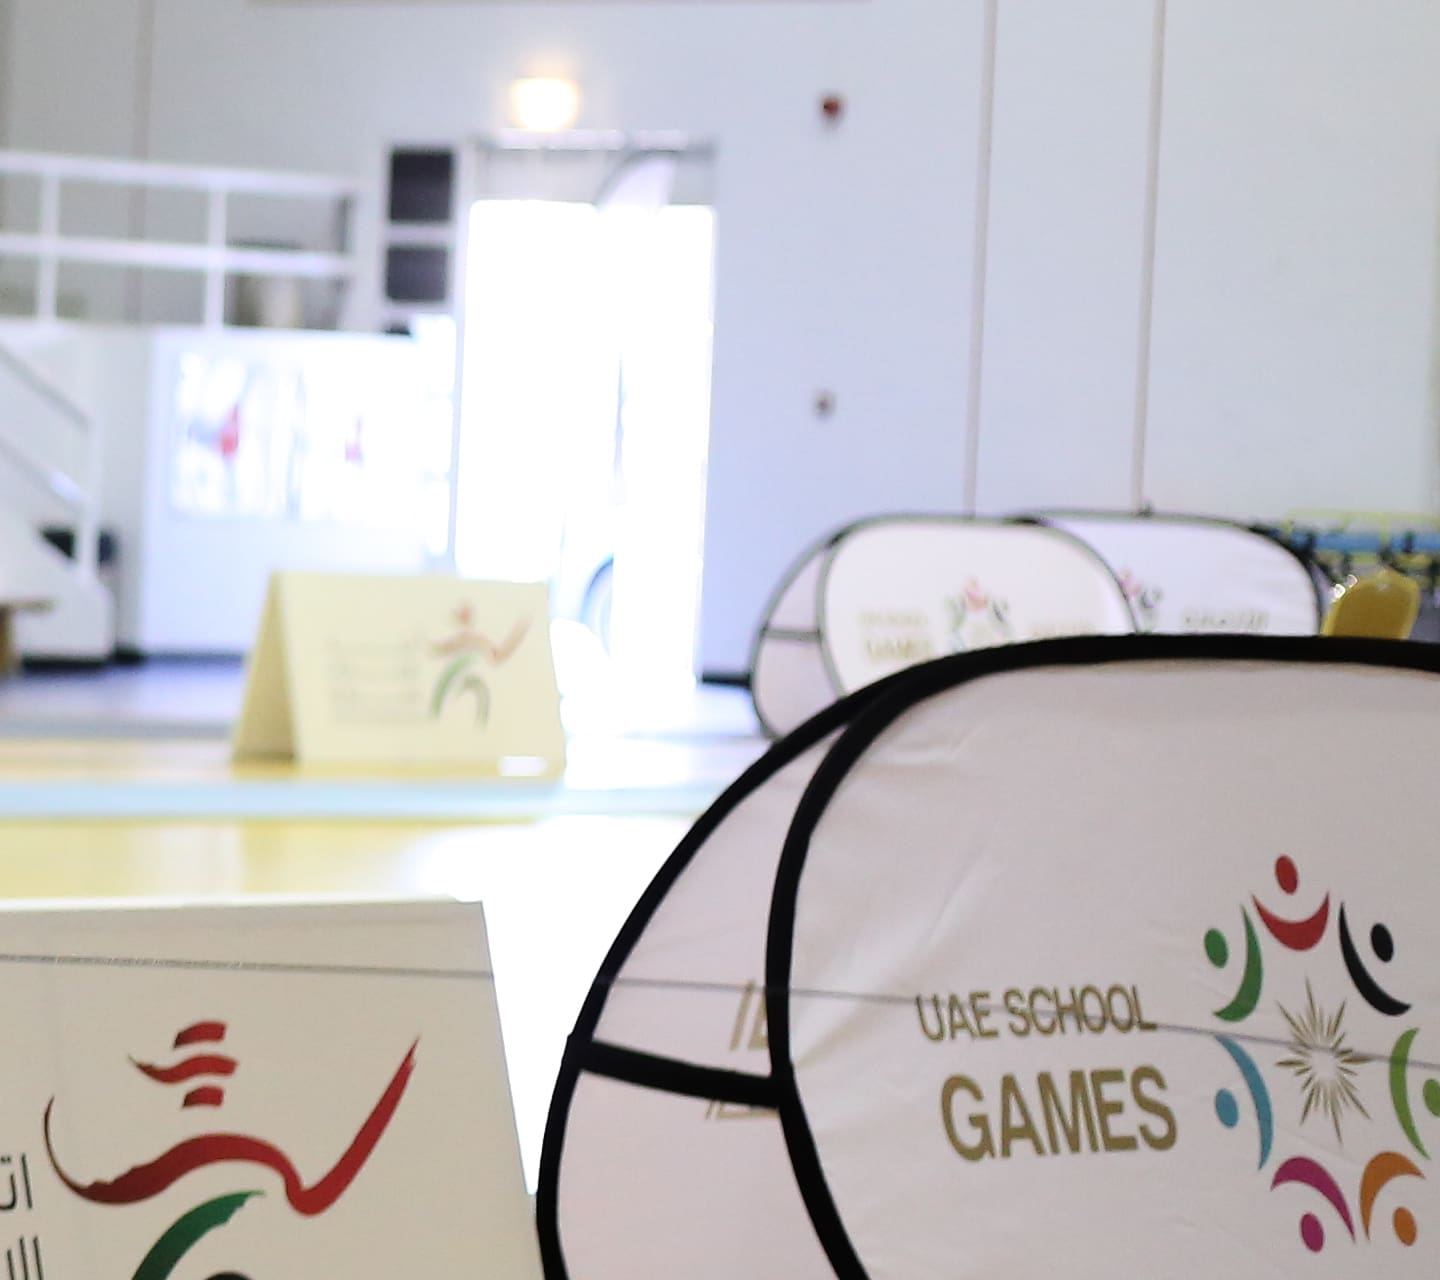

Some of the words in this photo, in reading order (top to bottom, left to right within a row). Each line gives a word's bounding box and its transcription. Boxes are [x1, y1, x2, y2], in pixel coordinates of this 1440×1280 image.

[915, 990, 998, 1043] UAE
[1006, 983, 1158, 1038] SCHOOL
[940, 1065, 1178, 1163] GAMES
